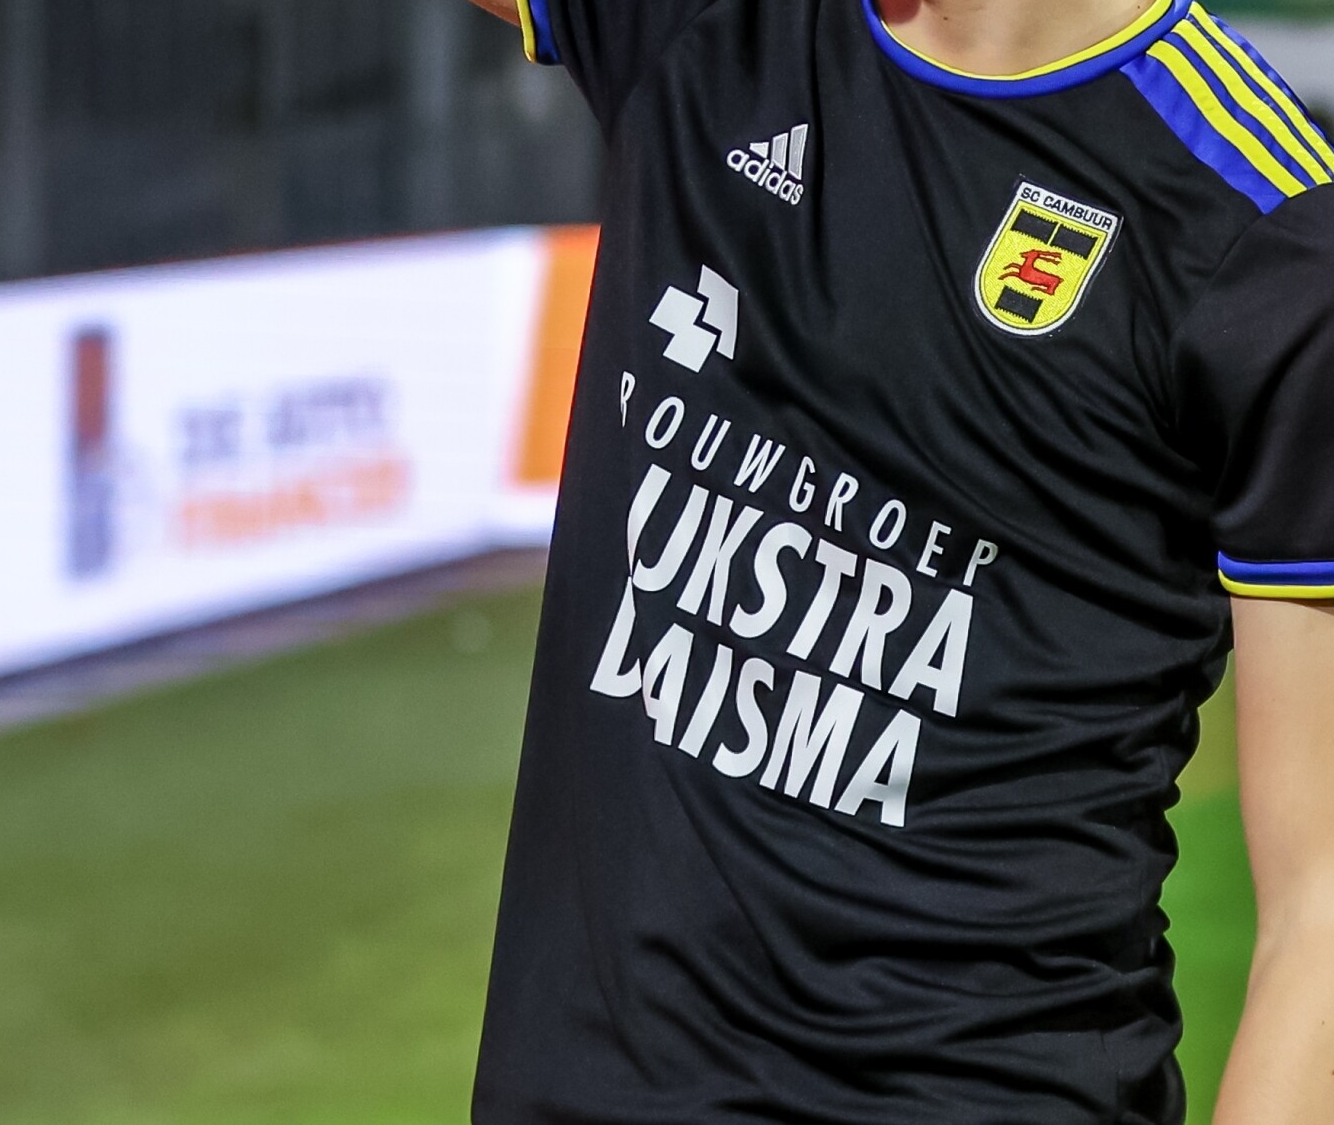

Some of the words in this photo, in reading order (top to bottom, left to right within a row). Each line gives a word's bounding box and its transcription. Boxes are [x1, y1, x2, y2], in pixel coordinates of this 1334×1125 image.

[727, 149, 804, 205] adidas
[1021, 187, 1040, 202] SC
[1043, 196, 1113, 231] CAMBUUR
